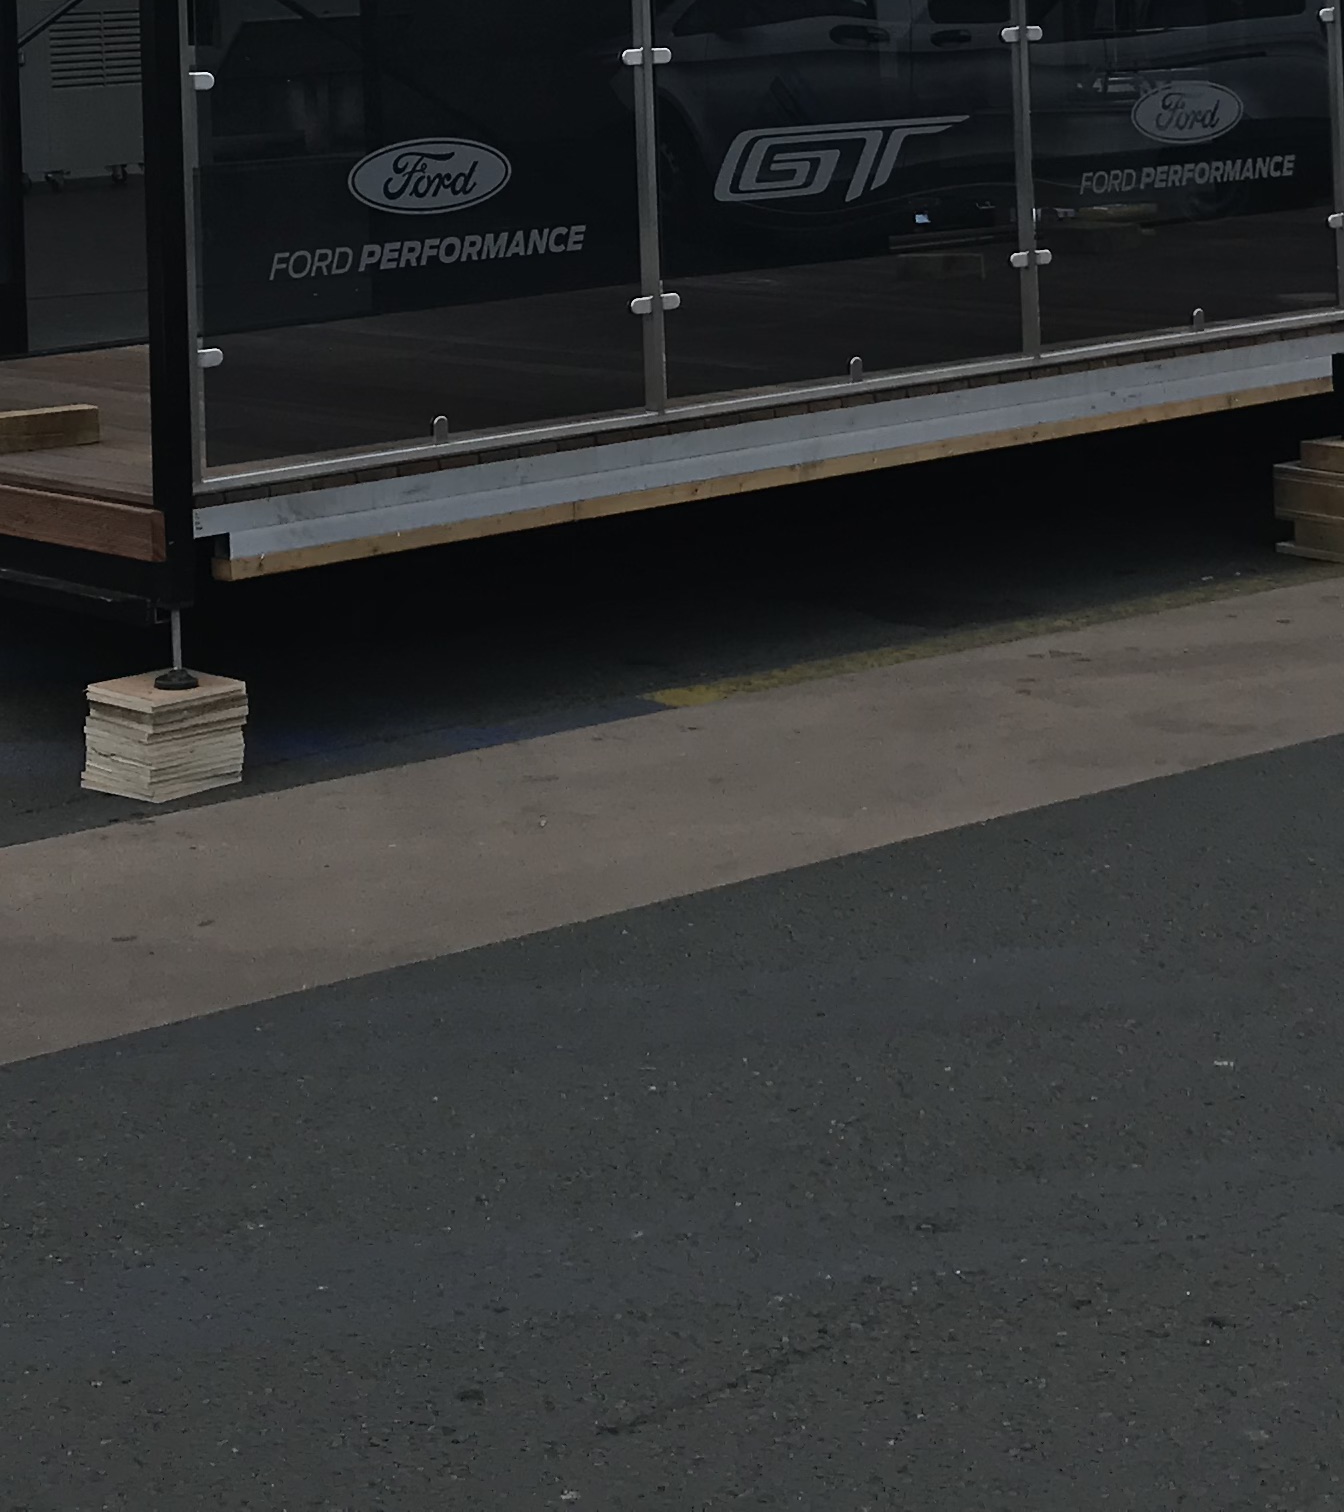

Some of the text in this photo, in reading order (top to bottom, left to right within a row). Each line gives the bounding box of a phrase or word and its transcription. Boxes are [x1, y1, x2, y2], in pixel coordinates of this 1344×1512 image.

[1156, 93, 1221, 130] Ford
[383, 152, 479, 200] Ford
[713, 114, 971, 203] GT
[1080, 154, 1297, 195] FORD PERFORMANCE
[268, 224, 587, 281] FORD PERFORMANCE
